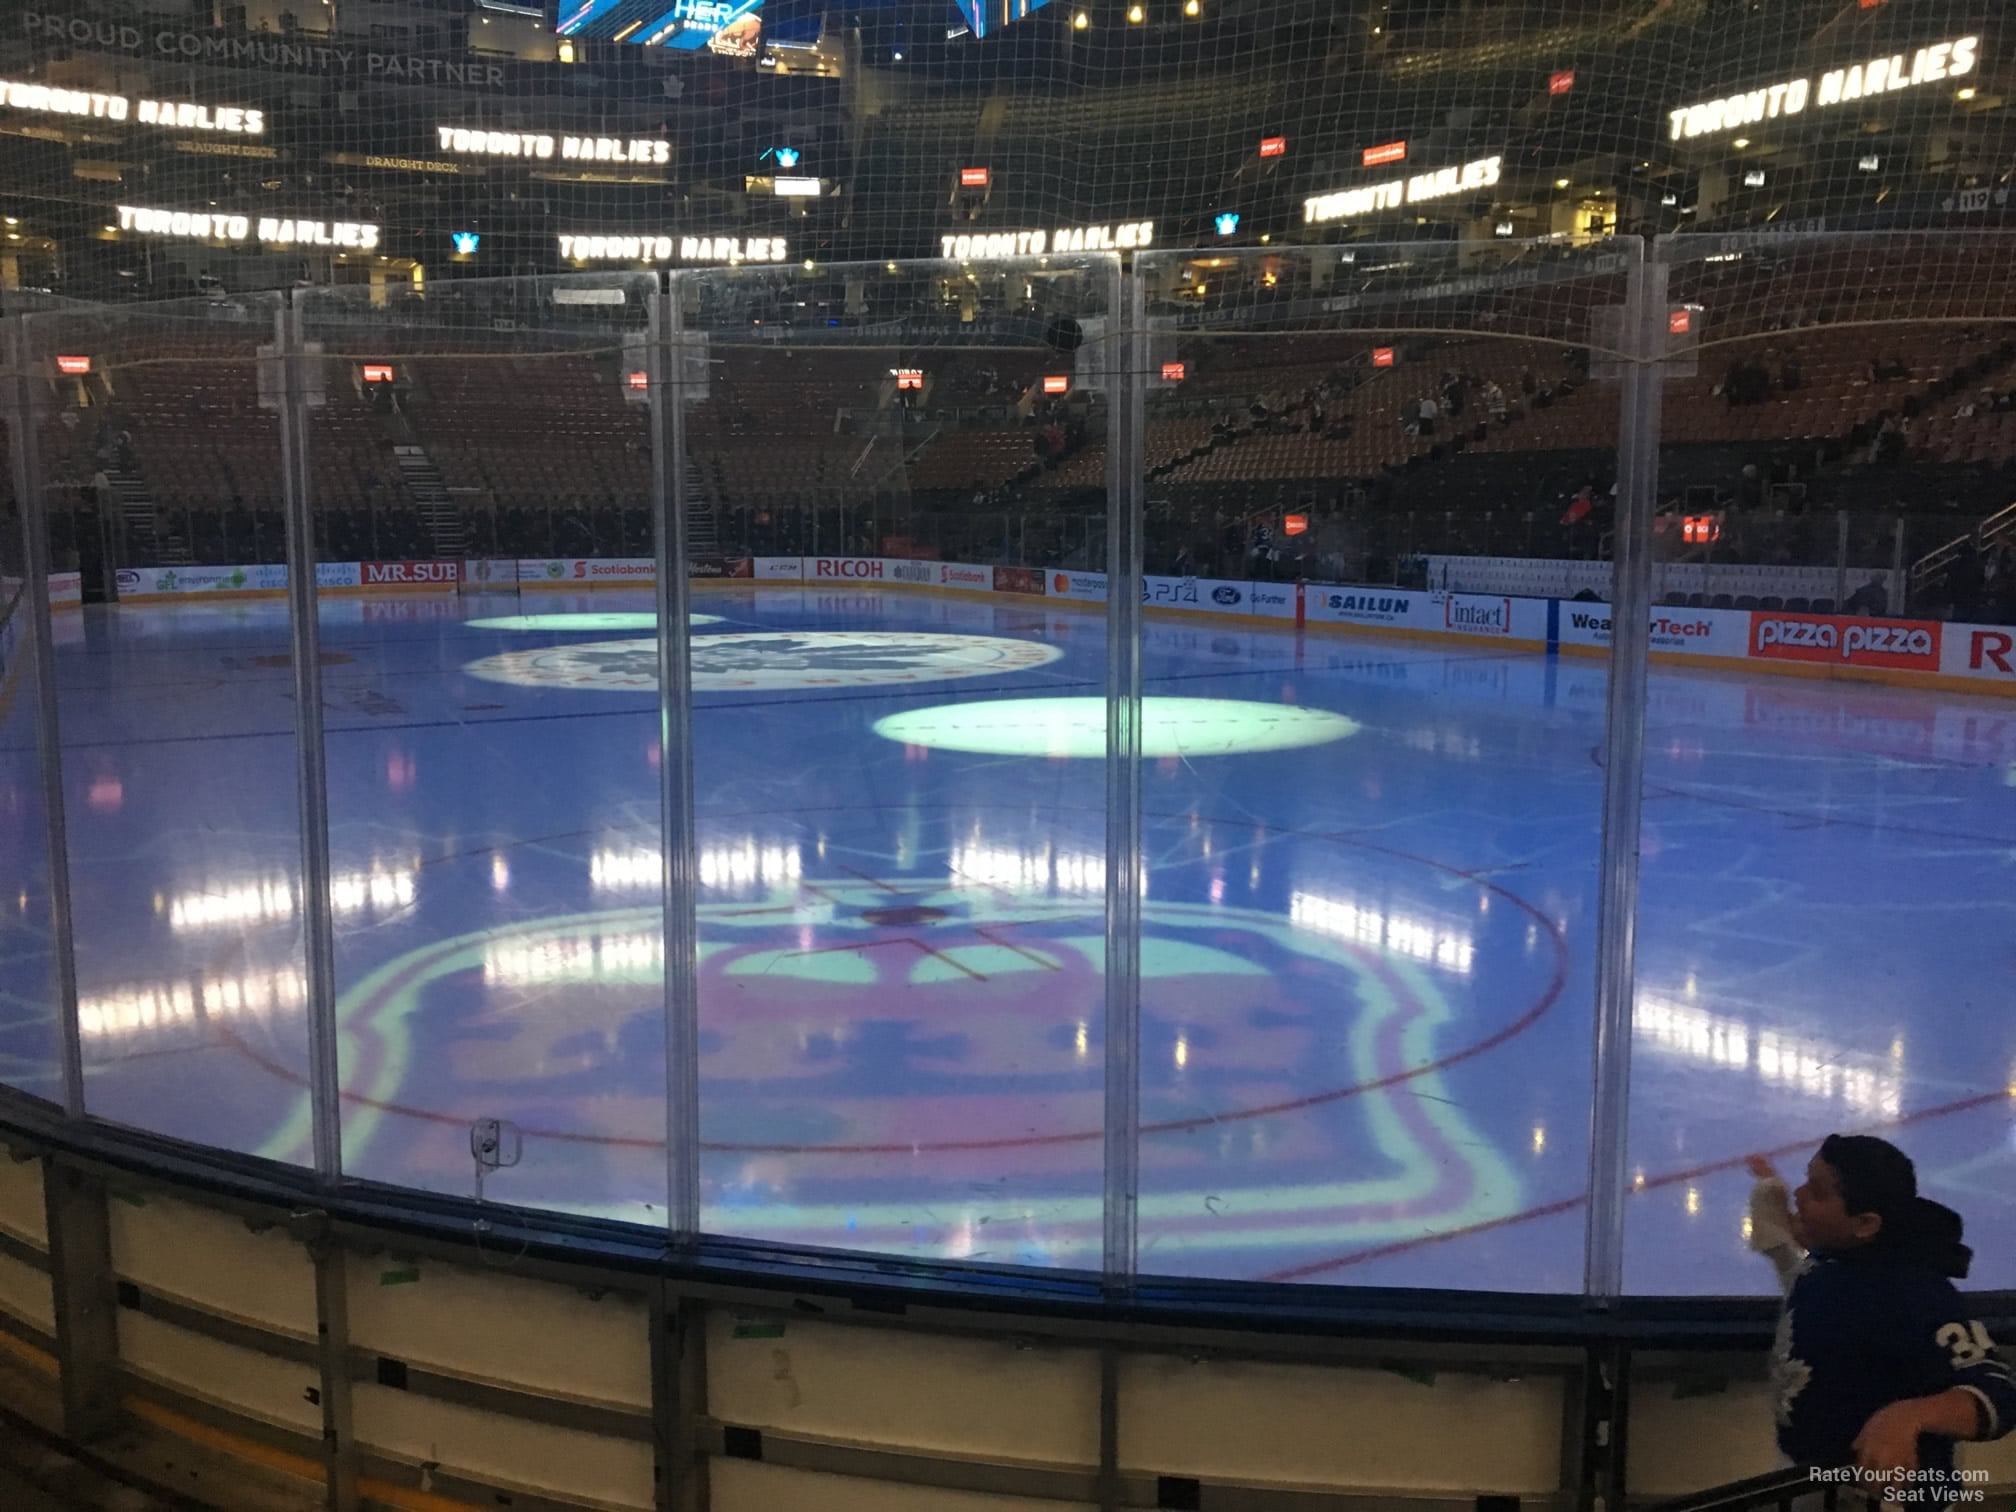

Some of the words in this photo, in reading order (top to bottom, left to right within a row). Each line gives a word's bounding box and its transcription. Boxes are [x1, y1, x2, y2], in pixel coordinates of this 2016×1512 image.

[24, 12, 142, 48] PROUD
[156, 31, 353, 71] COMMUNITY
[367, 52, 505, 87] PARTNER
[1670, 78, 1809, 141] TORONTO
[1818, 36, 1978, 106] MARLIES
[138, 100, 264, 134] MARLIES
[176, 140, 239, 155] DRAUGHT
[243, 146, 277, 158] DECK
[437, 126, 554, 158] TORONTO
[562, 136, 671, 163] MARLIES
[366, 155, 422, 170] DRAUGHT
[426, 162, 460, 173] DECK
[1304, 181, 1404, 223] TORONTO
[1407, 156, 1502, 203] MARLIES
[117, 205, 249, 240] TORONTO
[258, 217, 379, 249] MARLIES
[941, 230, 1046, 258] TORONTO
[1053, 221, 1154, 252] MARLIES
[558, 236, 673, 262] TORONTO
[680, 237, 788, 262] MARLIES
[367, 563, 457, 582] MR.SUB
[815, 559, 883, 579] RICOH
[1328, 595, 1410, 614] SAILUN
[1454, 601, 1502, 627] intact
[1571, 613, 1710, 637] WearTech
[1758, 619, 1838, 651] pizza
[1843, 624, 1933, 658] pizza
